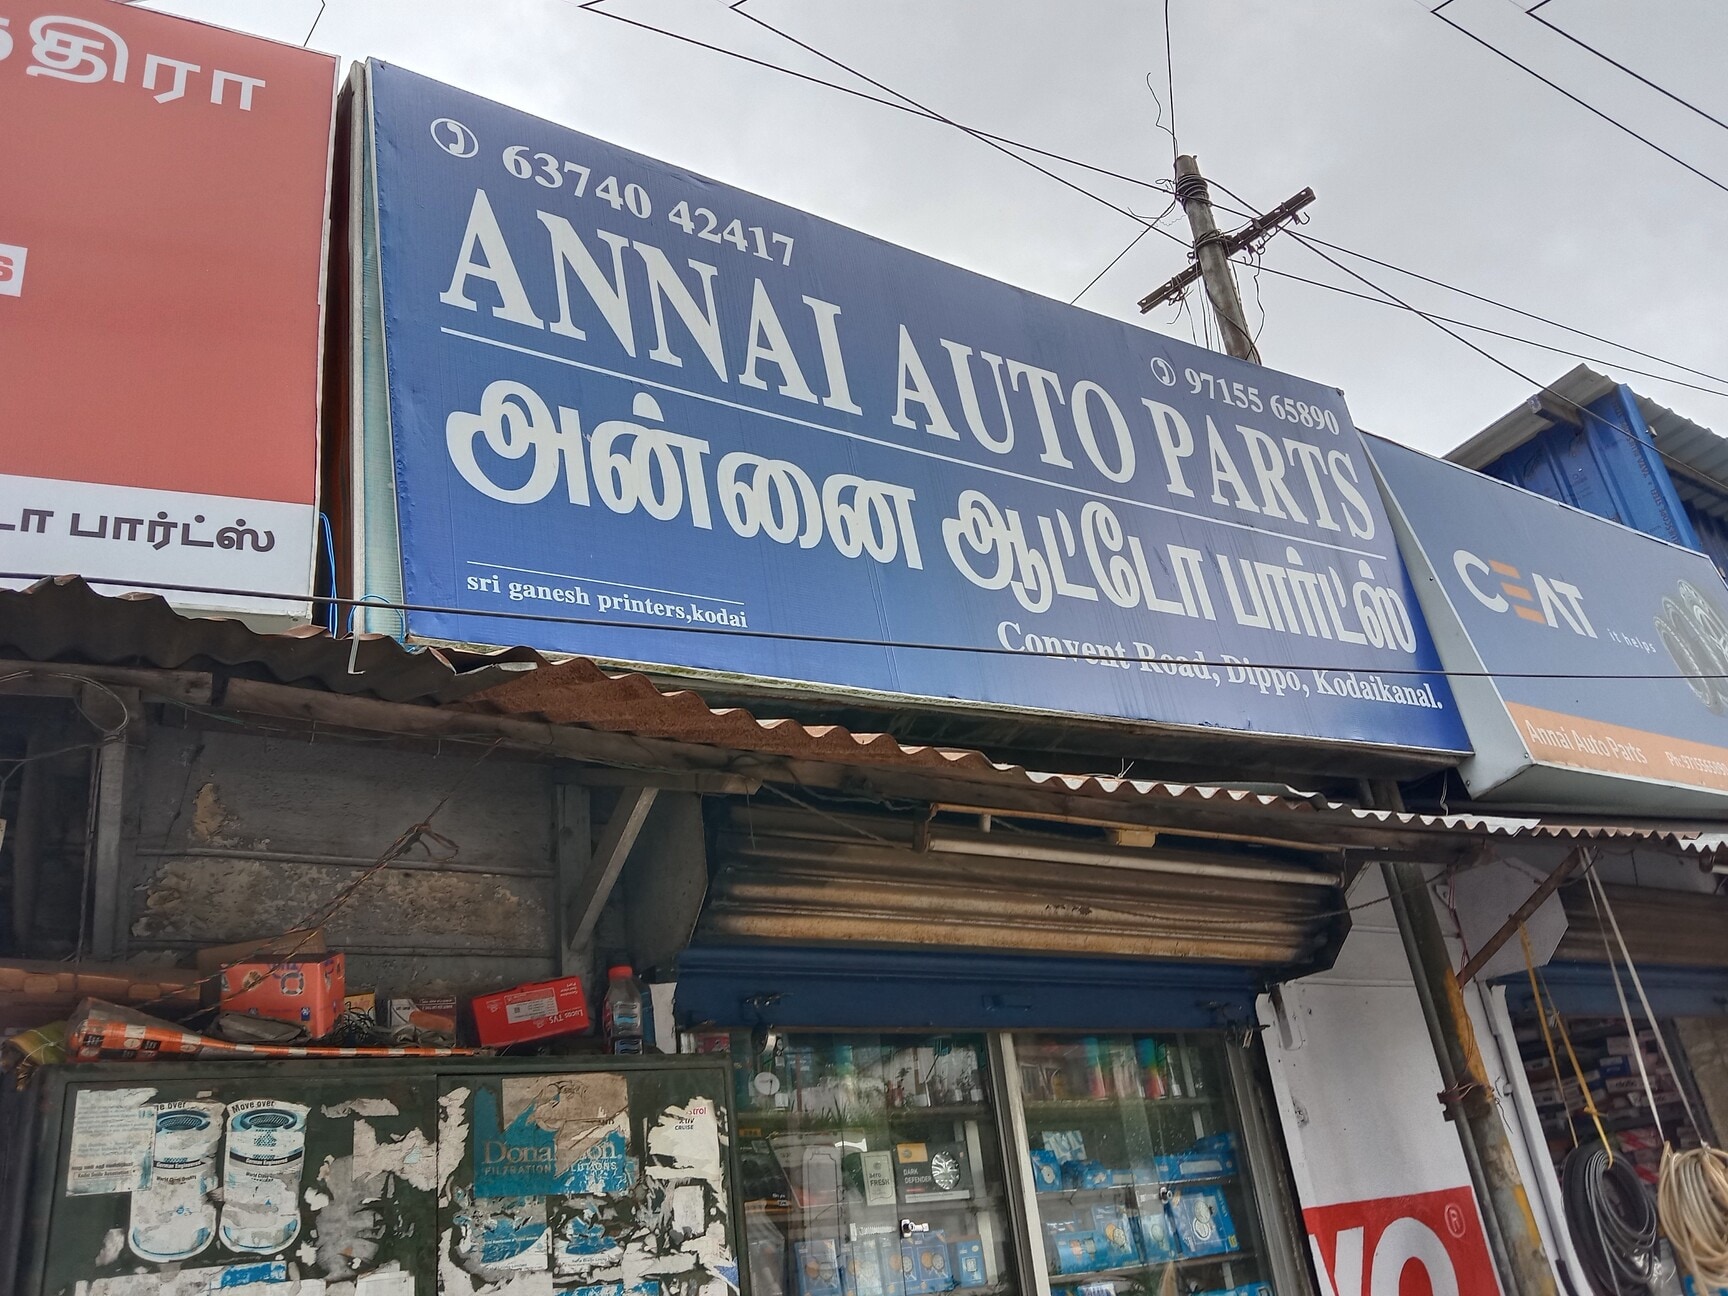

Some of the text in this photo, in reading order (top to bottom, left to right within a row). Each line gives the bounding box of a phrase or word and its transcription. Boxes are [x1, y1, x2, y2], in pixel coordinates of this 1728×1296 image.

[0, 15, 266, 111] திரா
[502, 145, 795, 266] 63740 42417
[440, 188, 1376, 541] ANNAI AUTO PARTS
[1184, 368, 1341, 435] 97155 65890
[69, 511, 275, 552] பார்ட்ஸ்
[446, 380, 1417, 654] அன்னை ஆட்டோ பார்ட்ஸ்
[466, 572, 748, 629] sri ganesh printers,kodai
[1453, 549, 1598, 638] CEAT
[1607, 628, 1656, 654] it helps
[997, 621, 1444, 710] Convent Road, Dippo, Kodaikanal.
[1525, 719, 1648, 764] Annai Auto Parts
[548, 1009, 583, 1024] Lucas TVS
[167, 1101, 186, 1110] over
[231, 1100, 275, 1113] Move over
[484, 1163, 550, 1176] FILTRATION
[870, 1179, 890, 1187] FRESH
[903, 1168, 919, 1176] DARK
[904, 1174, 933, 1184] DEFENDER
